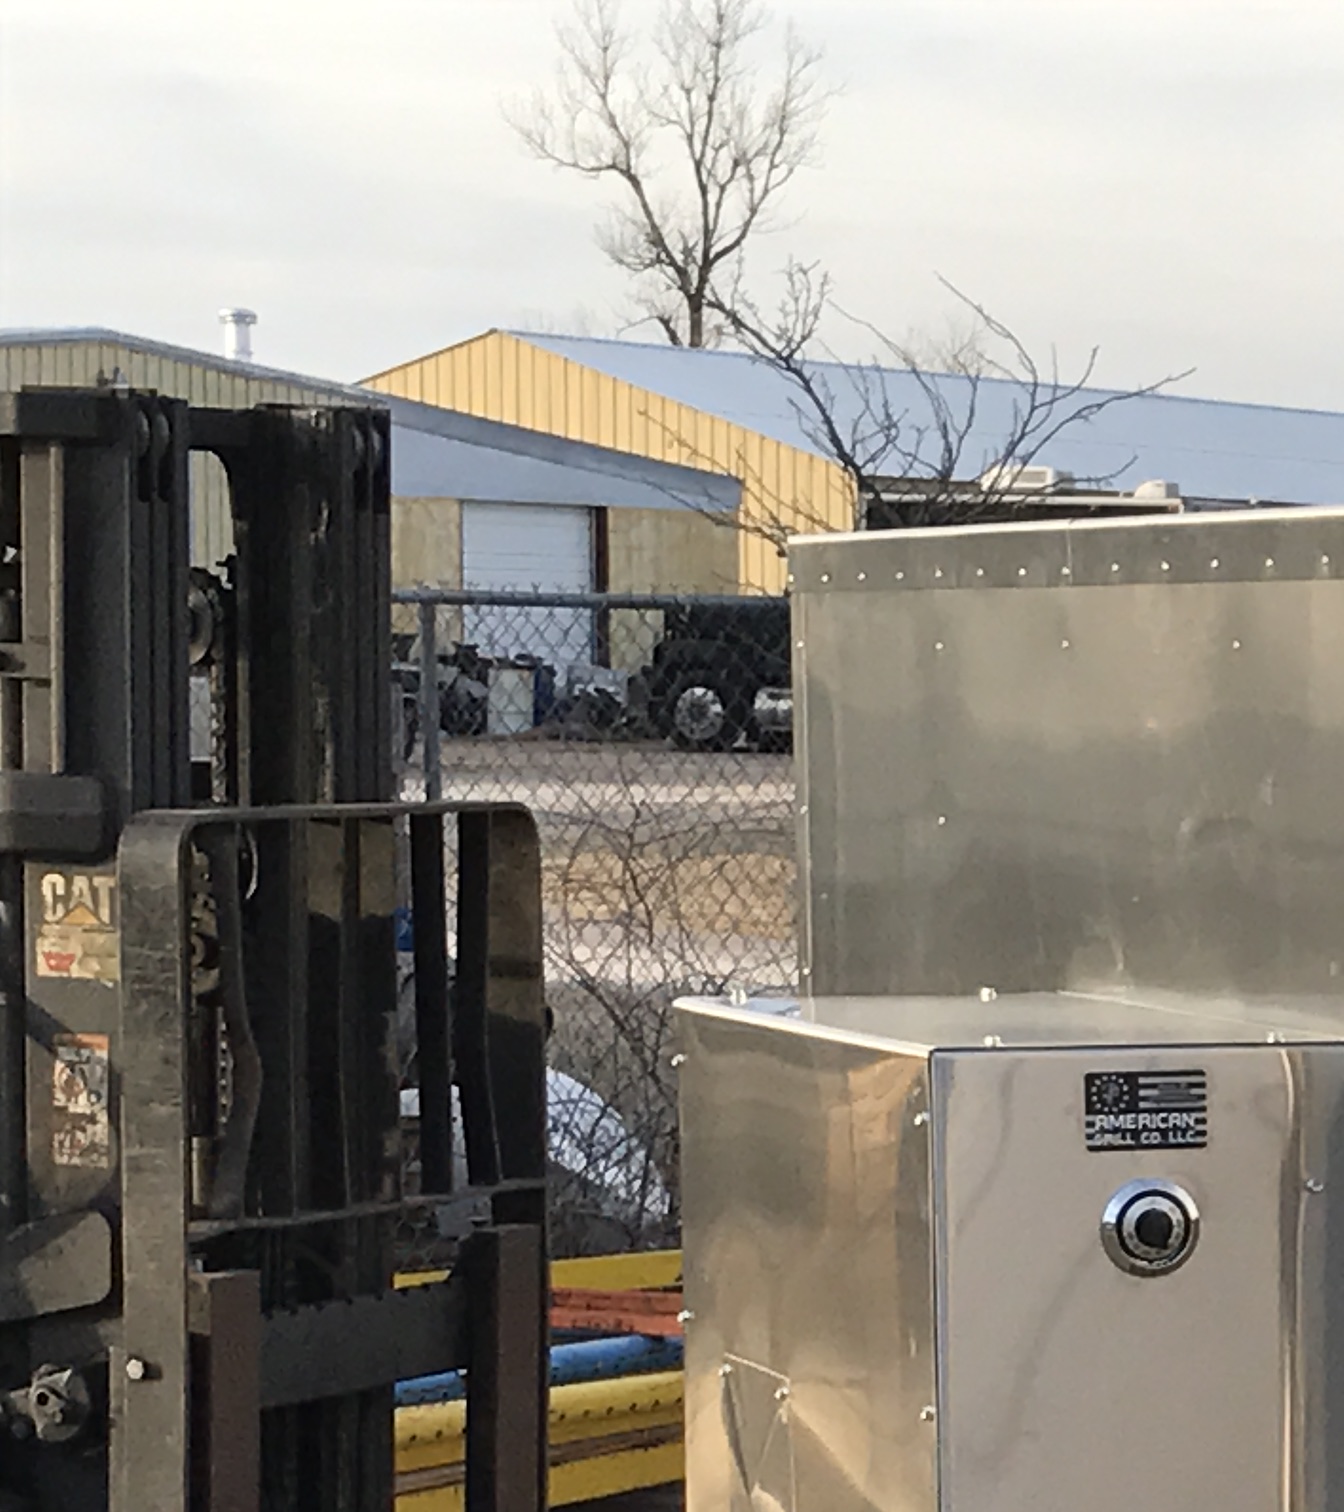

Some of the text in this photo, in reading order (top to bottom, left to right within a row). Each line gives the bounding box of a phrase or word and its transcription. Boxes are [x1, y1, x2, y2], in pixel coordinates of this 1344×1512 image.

[42, 873, 116, 924] CAT
[1094, 1112, 1195, 1130] AMERICAN
[1168, 1131, 1196, 1143] LLC
